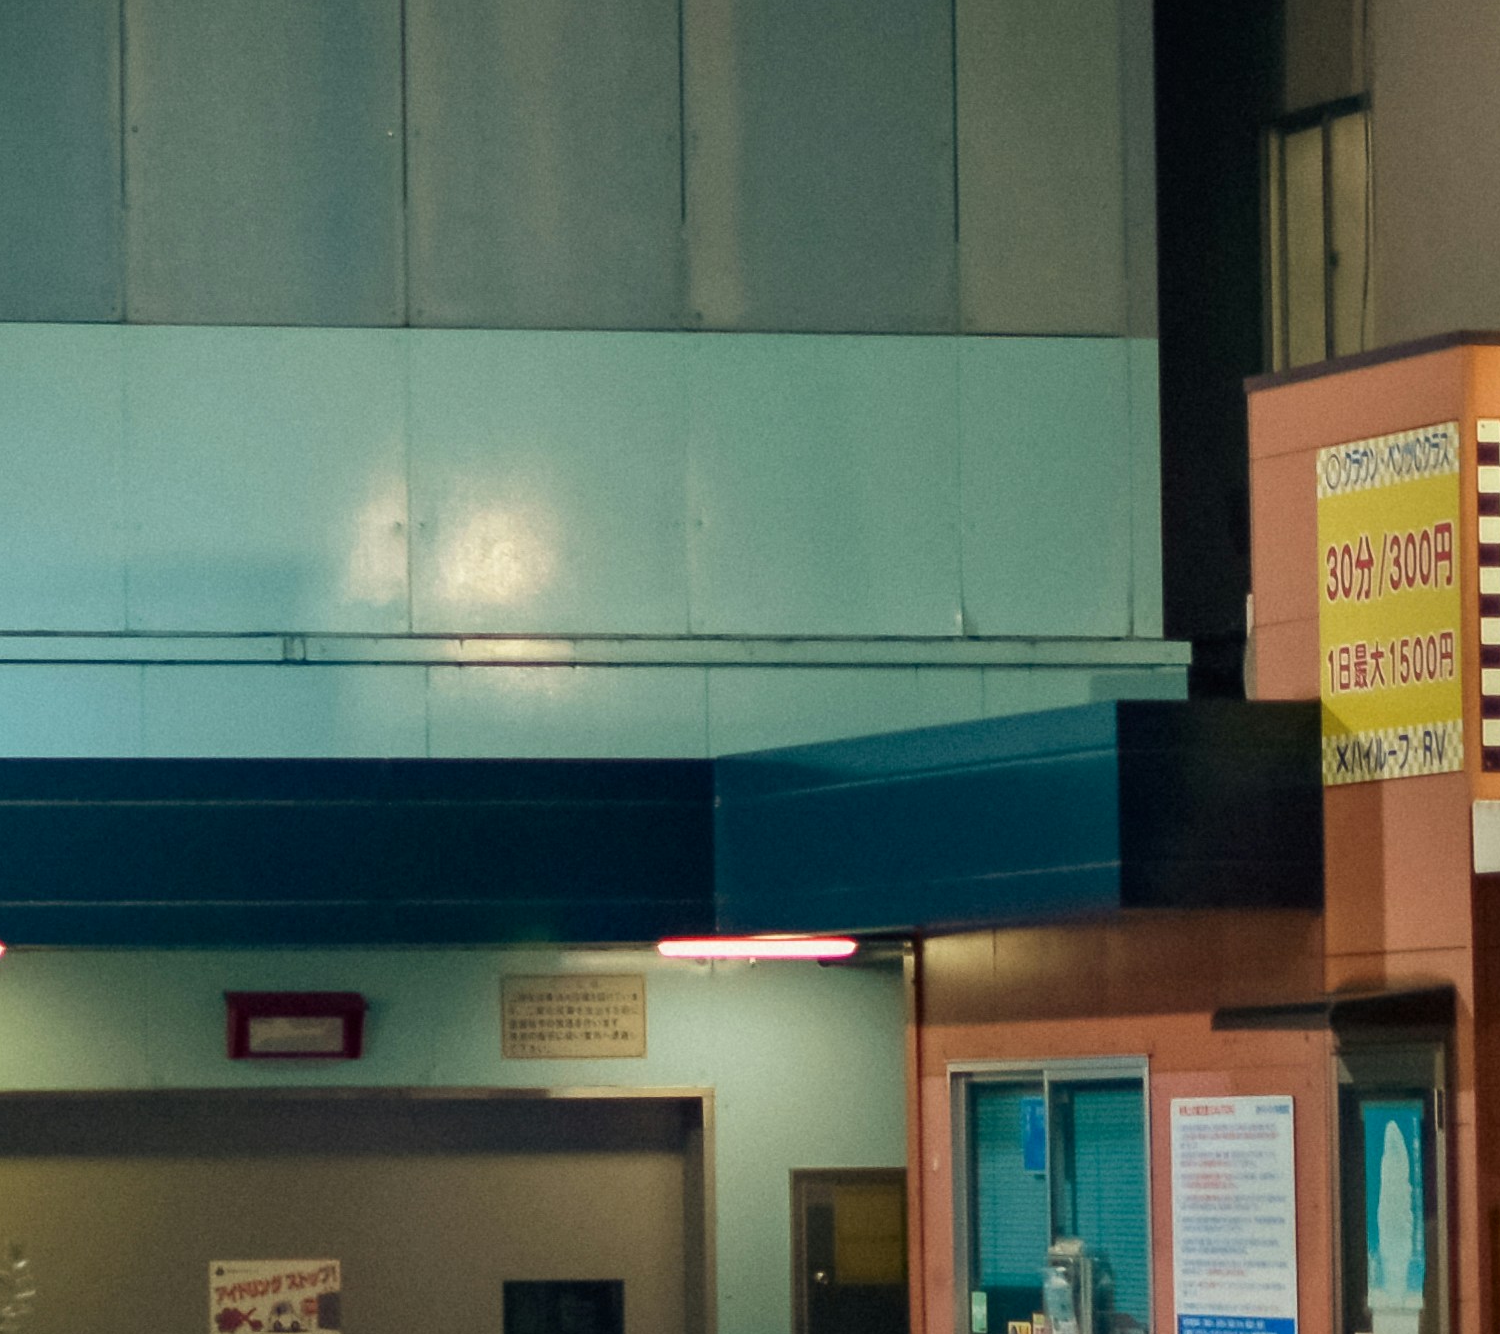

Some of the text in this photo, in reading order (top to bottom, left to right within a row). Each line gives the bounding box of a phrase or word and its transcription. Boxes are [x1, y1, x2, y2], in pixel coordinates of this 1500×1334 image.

[1326, 522, 1454, 602] 30分/300円
[1327, 631, 1454, 695] 1日最大1500円
